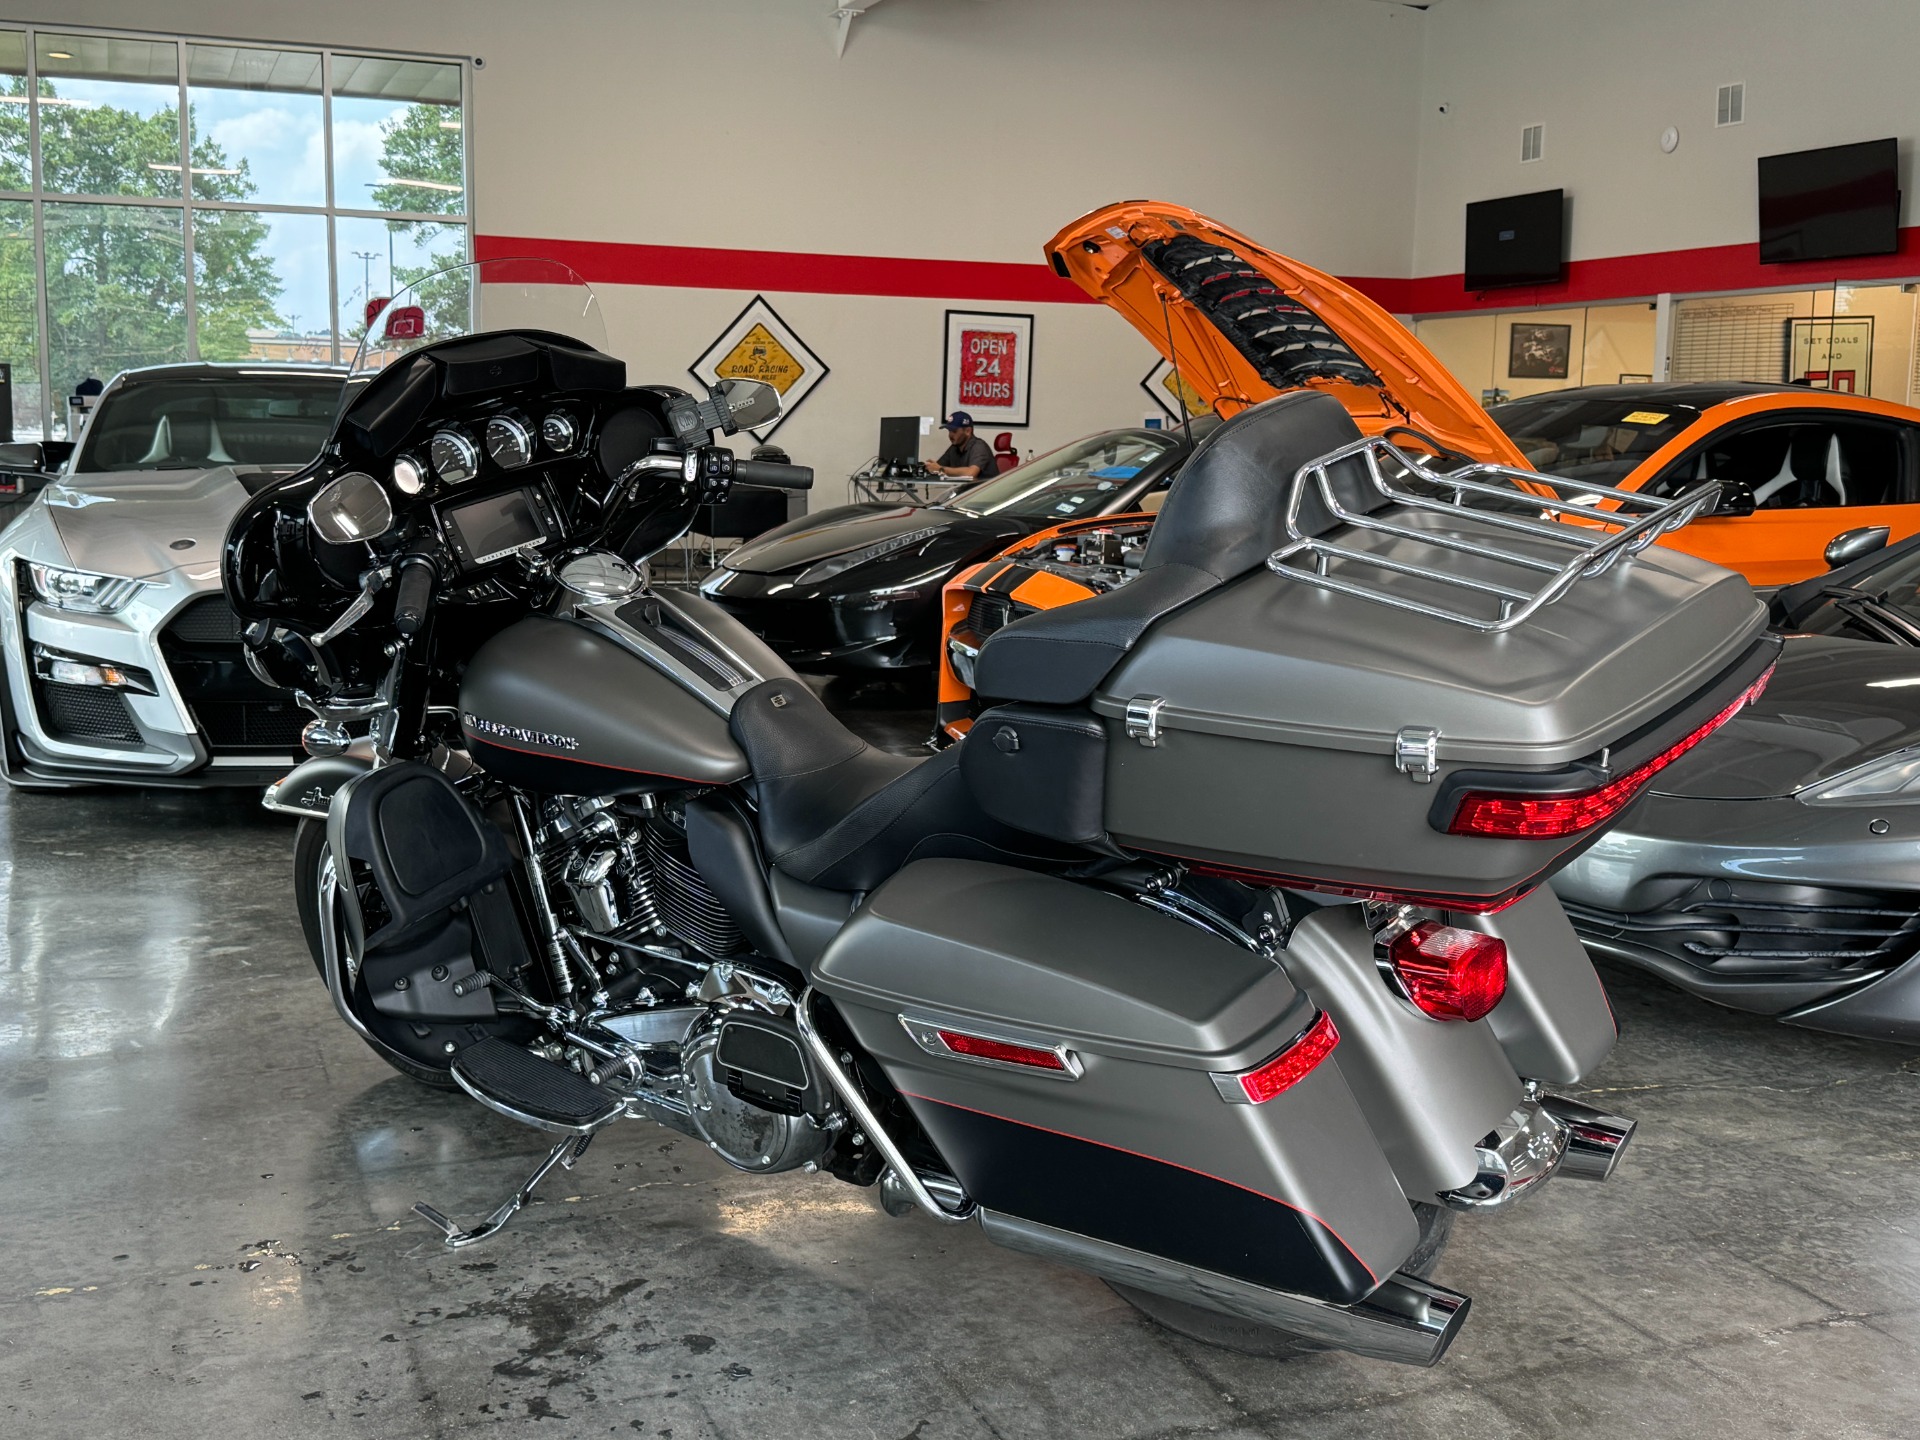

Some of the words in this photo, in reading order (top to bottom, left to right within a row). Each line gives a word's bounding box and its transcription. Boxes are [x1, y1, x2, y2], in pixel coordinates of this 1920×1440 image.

[970, 337, 1008, 355] OPEN
[1826, 336, 1859, 344] GOALS
[731, 364, 755, 373] ROAD
[758, 364, 789, 374] RACING
[975, 357, 1001, 377] 24
[963, 381, 1010, 399] HOURS
